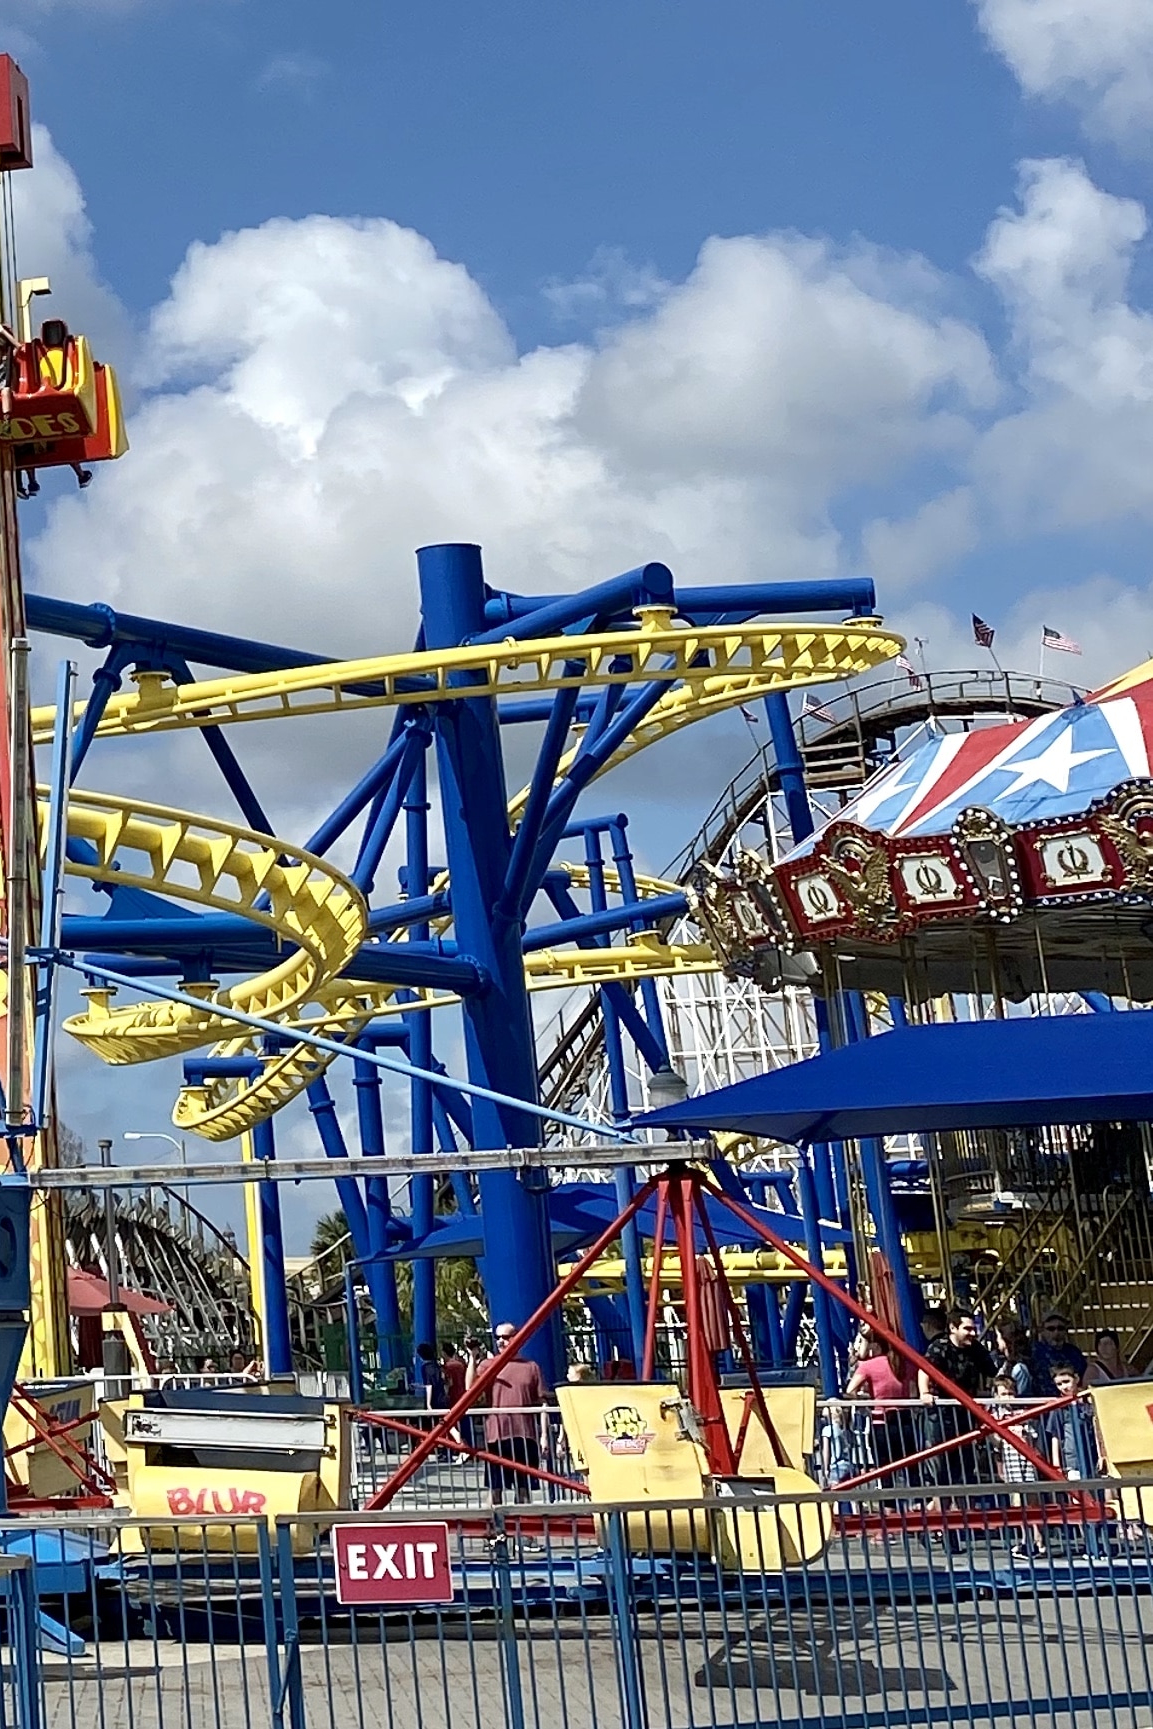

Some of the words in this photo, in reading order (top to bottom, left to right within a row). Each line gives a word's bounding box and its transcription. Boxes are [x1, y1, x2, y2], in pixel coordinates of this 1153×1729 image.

[604, 1408, 641, 1430] FUN
[606, 1420, 647, 1439] SPOT
[166, 1487, 267, 1516] BLUR
[347, 1542, 439, 1580] EXIT
